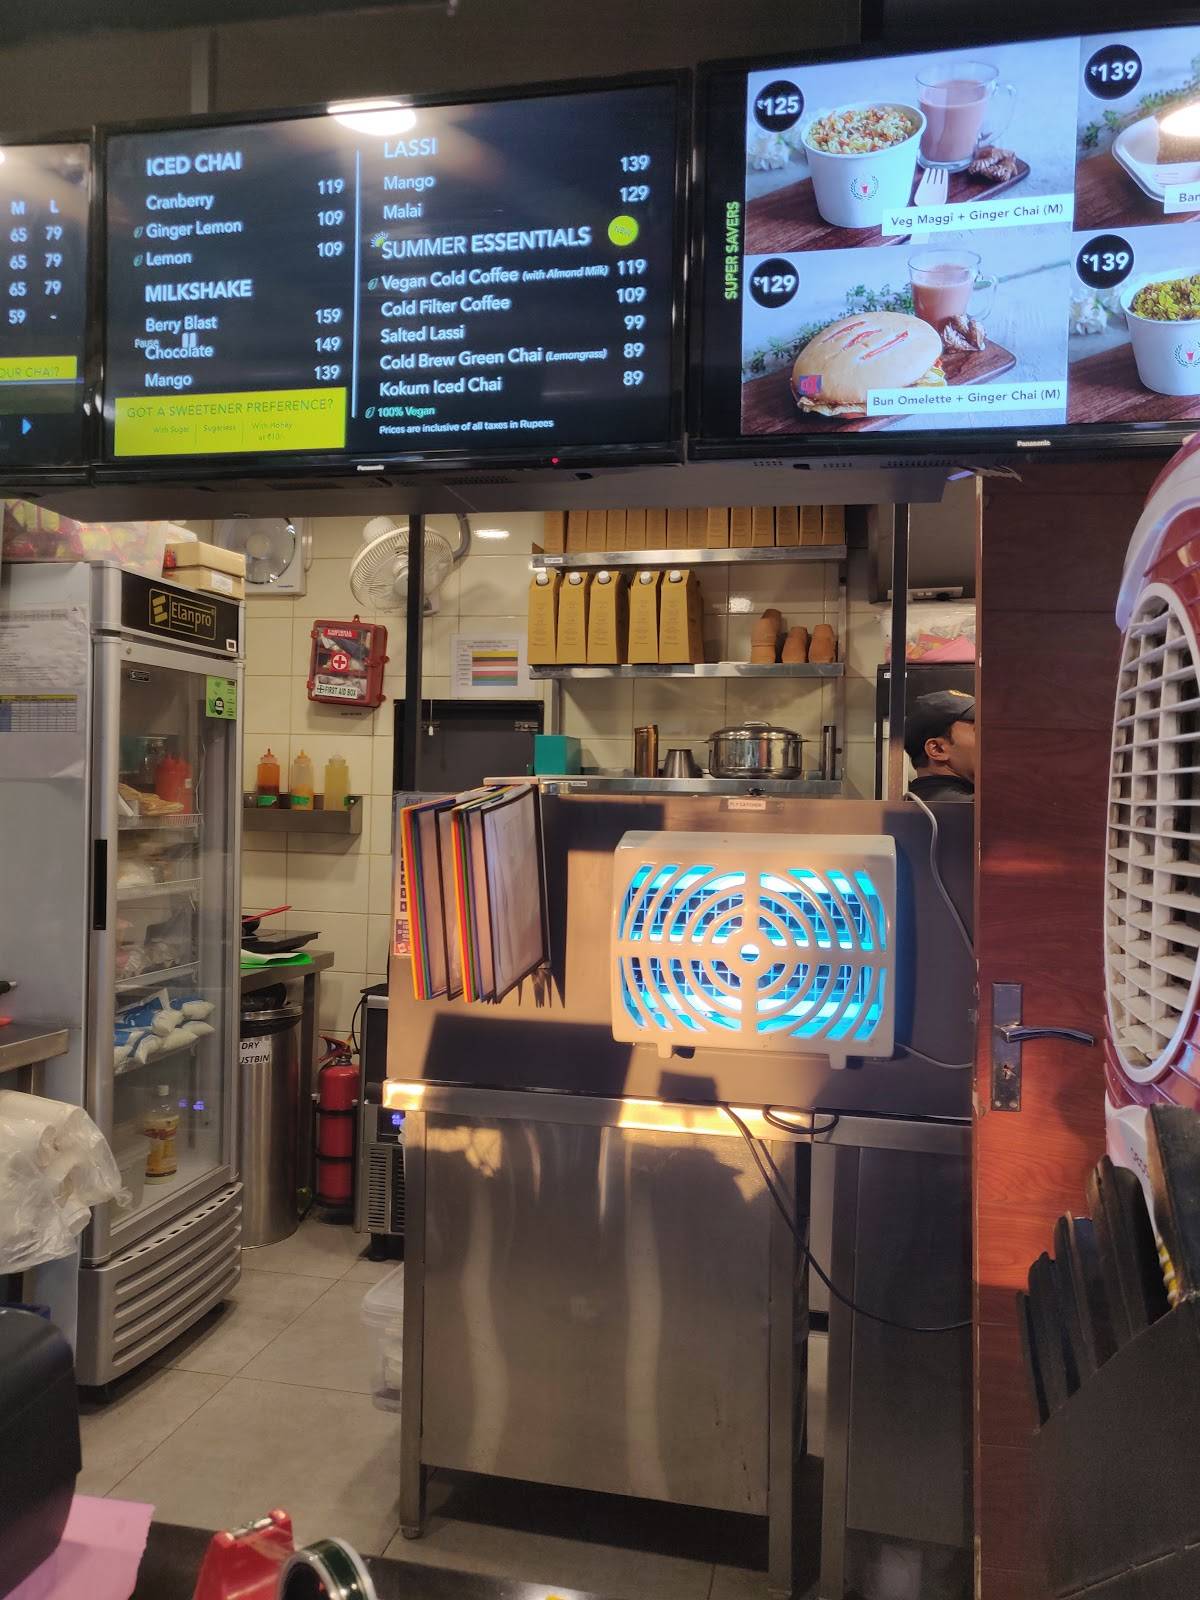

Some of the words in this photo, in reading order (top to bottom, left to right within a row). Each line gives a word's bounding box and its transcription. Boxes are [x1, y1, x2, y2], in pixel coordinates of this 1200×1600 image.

[384, 137, 438, 158] LASSI
[146, 156, 191, 176] ICED
[195, 152, 242, 173] CHAI
[620, 155, 650, 172] 139
[317, 178, 344, 195] 119
[383, 175, 435, 192] Mango
[146, 193, 214, 210] Cranberry
[619, 185, 649, 202] 129
[11, 200, 25, 216] M
[49, 199, 60, 214] L
[383, 203, 422, 219] Malai
[891, 217, 913, 227] Veg
[917, 213, 954, 225] Maggi
[957, 213, 966, 221] +
[969, 208, 1009, 222] Ginger
[1013, 206, 1040, 217] Chai
[1043, 203, 1064, 215] (M)
[317, 209, 344, 226] 109
[9, 227, 28, 243] 65
[45, 225, 63, 241] 79
[146, 222, 193, 240] Ginger
[195, 221, 243, 236] Lemon
[726, 201, 741, 254] SAVERS
[316, 241, 344, 258] 109
[381, 236, 466, 259] SUMMER
[471, 226, 592, 253] ESSENTIALS
[9, 254, 28, 270] 65
[45, 252, 62, 268] 79
[146, 252, 193, 266] Lemon
[617, 259, 647, 275] 119
[1082, 251, 1130, 272] ₹139
[382, 275, 427, 292] Vegan
[430, 269, 466, 287] Cold
[468, 266, 519, 284] Coffee
[522, 269, 545, 282] (with
[546, 266, 585, 279] Almond
[724, 255, 740, 301] SUPER
[9, 281, 27, 297] 65
[44, 279, 62, 296] 79
[145, 279, 253, 303] MILKSHAKE
[616, 286, 646, 304] 109
[381, 301, 417, 318] Cold
[419, 299, 457, 315] Filter
[460, 294, 512, 312] Coffee
[8, 308, 27, 325] 59
[145, 317, 181, 335] Berry
[184, 314, 218, 330] Blast
[315, 307, 341, 325] 159
[624, 314, 644, 331] 99
[380, 328, 427, 344] Salted
[430, 324, 465, 341] Lassi
[134, 338, 160, 350] Pause
[145, 345, 214, 360] Chocolate
[314, 337, 341, 353] 149
[623, 342, 645, 358] 89
[380, 354, 416, 371] Cold
[418, 350, 455, 369] Brew
[458, 349, 504, 366] Green
[508, 347, 543, 363] Chai
[546, 348, 608, 362] (Lemongrass)
[145, 373, 193, 390] Mango
[314, 365, 341, 382] 139
[622, 370, 644, 386] 89
[380, 380, 430, 397] Kokum
[432, 377, 465, 394] Iced
[467, 375, 503, 392] Chai
[872, 396, 894, 406] Bun
[897, 395, 952, 405] Omelette
[955, 395, 964, 403] +
[967, 391, 1007, 404] Ginger
[1011, 389, 1037, 400] Chai
[1041, 389, 1061, 401] (M)
[126, 406, 154, 418] GOT
[156, 406, 166, 417] A
[169, 402, 242, 416] SWEETENER
[246, 398, 334, 412] PREFERENCE?
[377, 407, 404, 418] 100%
[405, 406, 436, 419] Vegan
[379, 424, 405, 435] Prices
[406, 424, 420, 433] are
[422, 421, 459, 433] inclusive
[460, 421, 471, 431] of
[472, 421, 483, 430] all
[484, 420, 507, 430] taxes
[509, 419, 519, 428] in
[520, 418, 554, 428] Rupees
[171, 601, 212, 633] Elanpro
[324, 685, 338, 695] FIRST
[338, 686, 347, 695] AID
[347, 688, 357, 696] BOX
[241, 1041, 260, 1049] DRY
